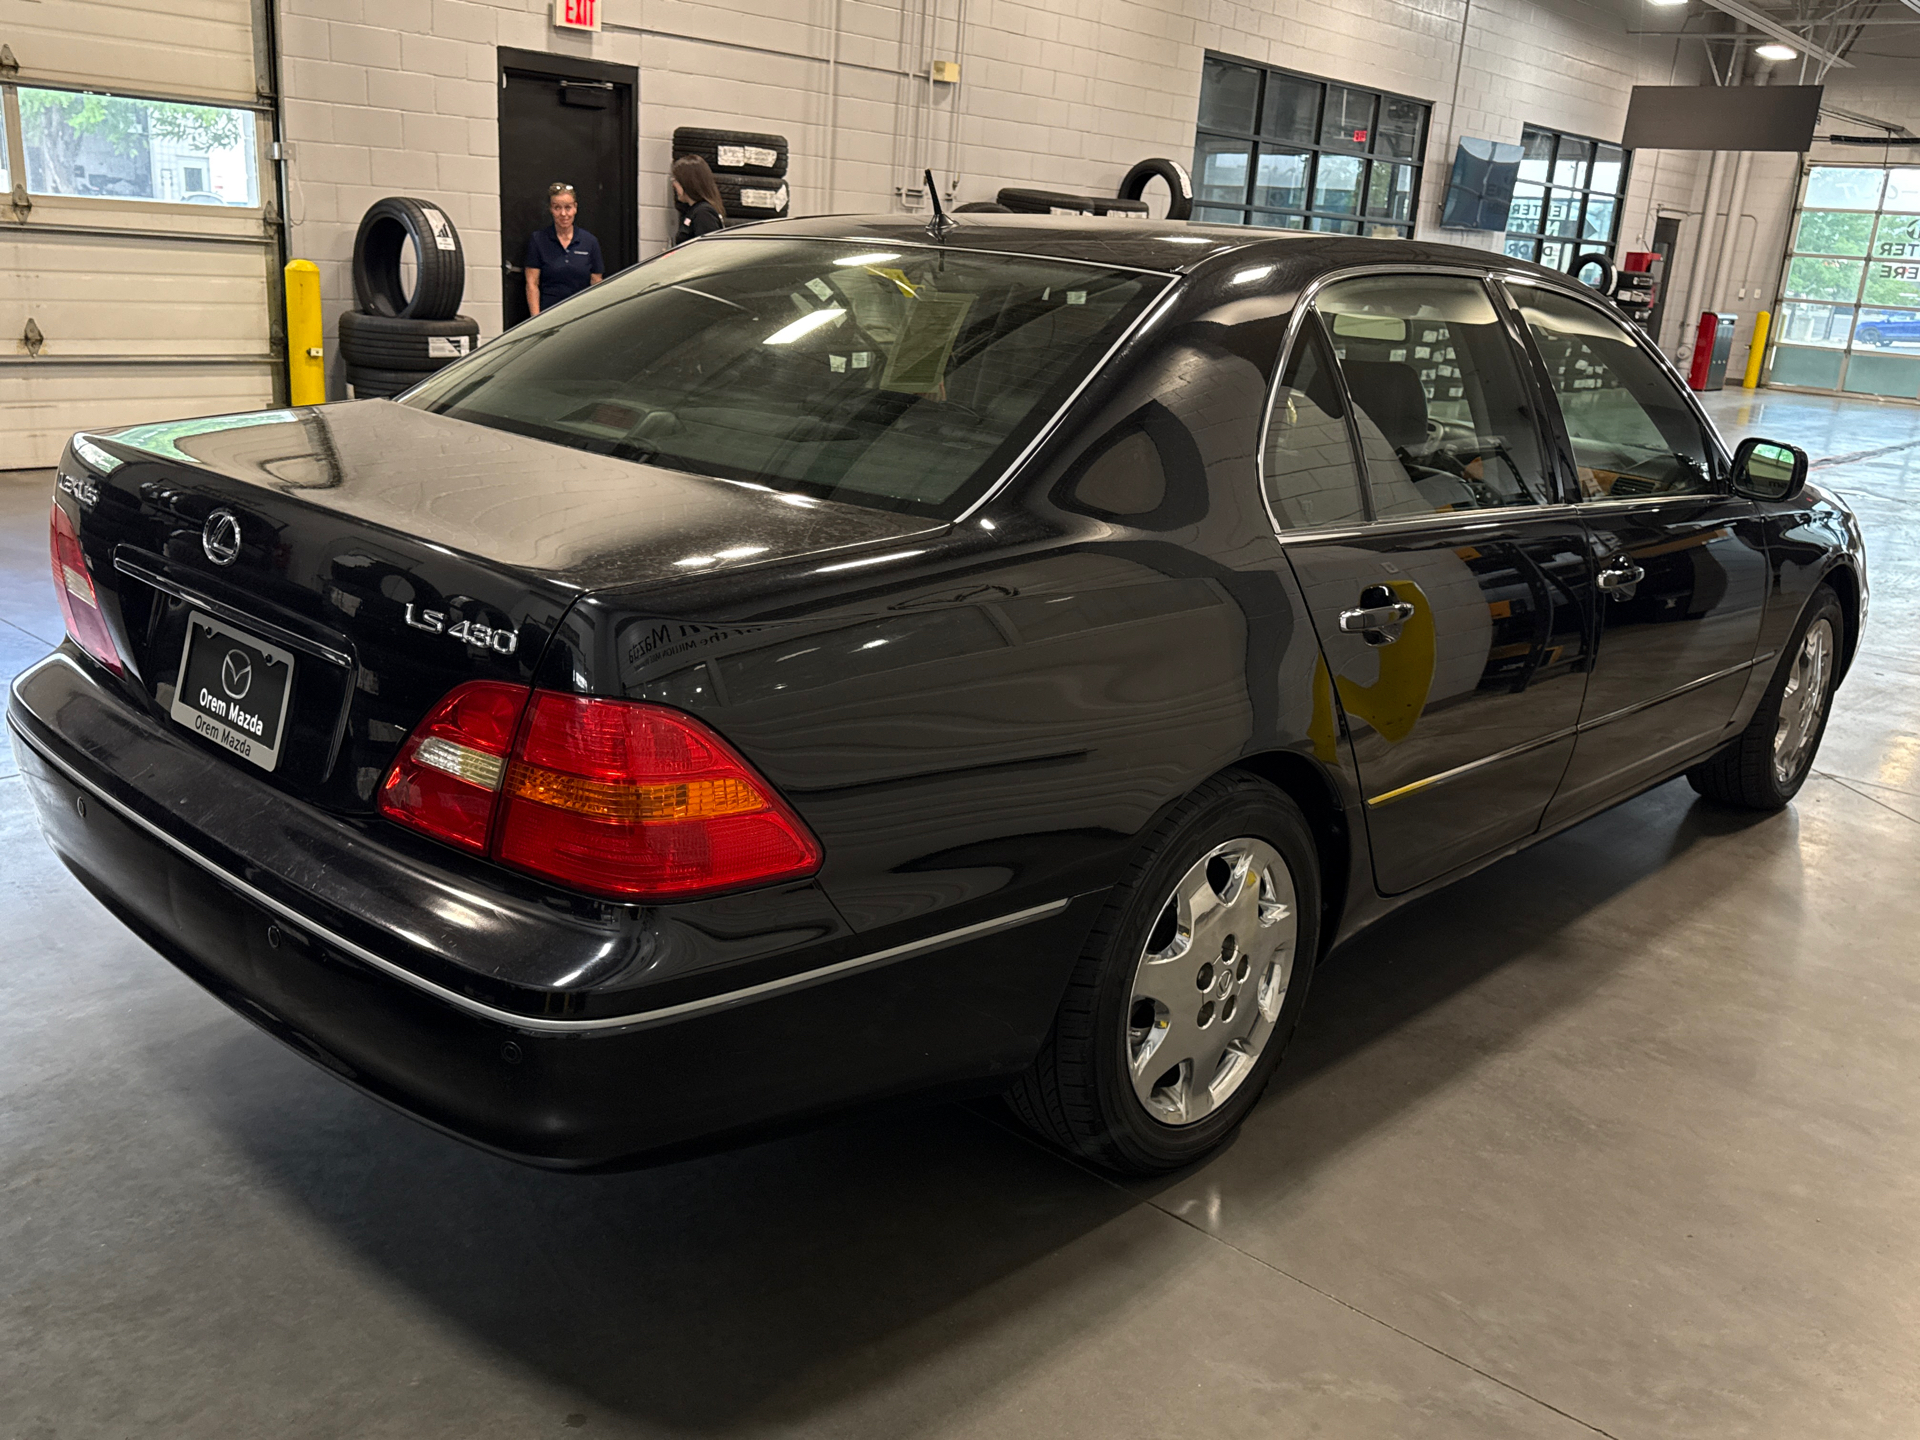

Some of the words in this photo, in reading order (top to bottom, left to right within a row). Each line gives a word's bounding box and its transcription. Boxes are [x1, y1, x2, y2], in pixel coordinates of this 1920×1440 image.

[565, 0, 596, 27] EXIT
[59, 472, 99, 506] LEXUS
[405, 603, 444, 634] LS
[448, 620, 517, 655] 430
[199, 688, 227, 717] Orem
[228, 702, 264, 736] Mazda
[195, 715, 220, 740] Orem
[221, 728, 252, 757] Mazda
